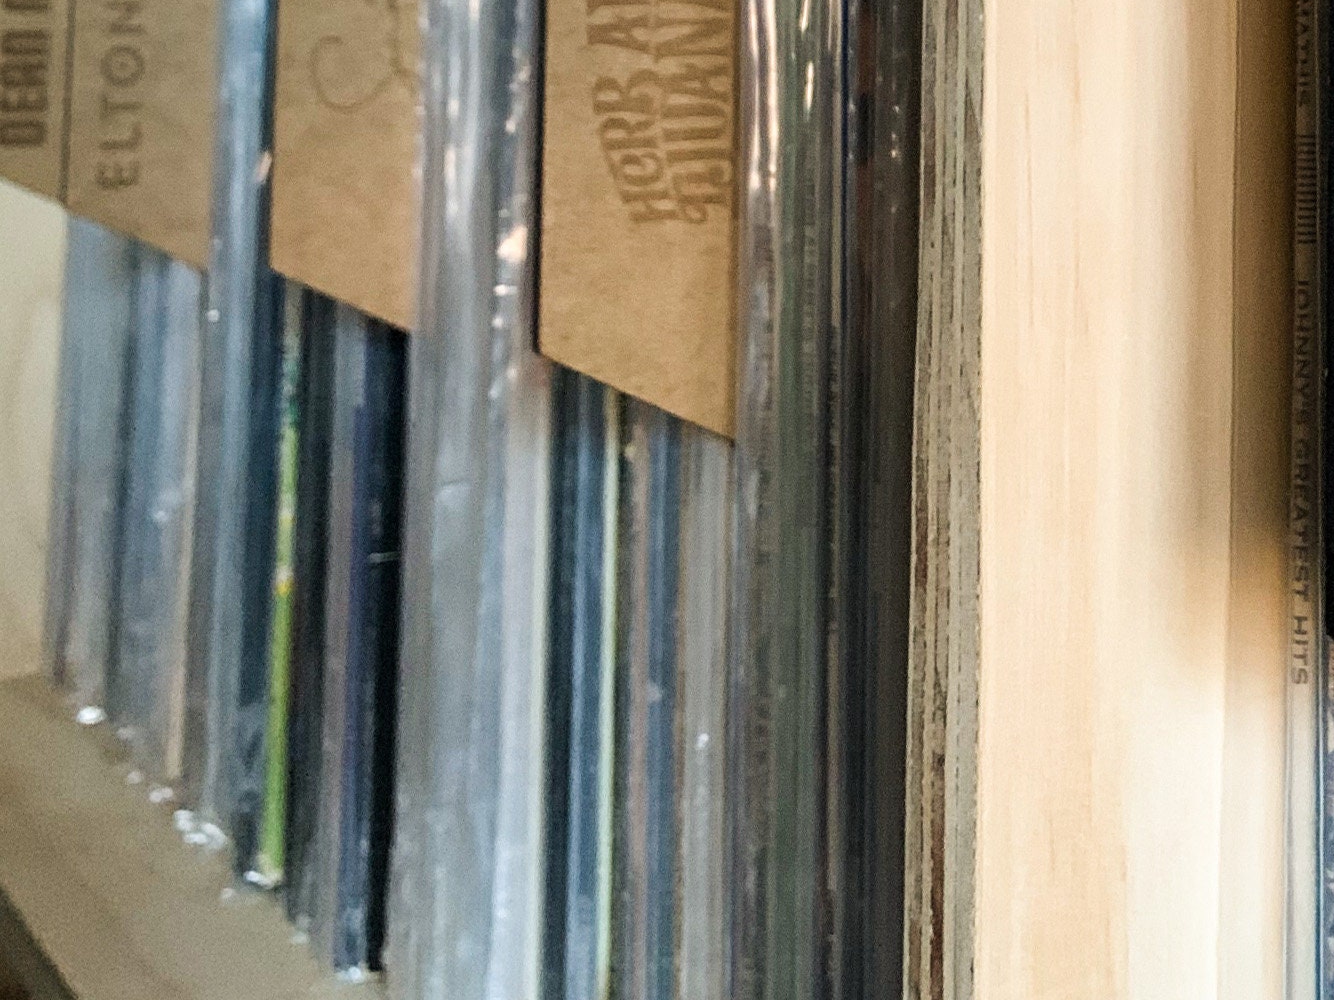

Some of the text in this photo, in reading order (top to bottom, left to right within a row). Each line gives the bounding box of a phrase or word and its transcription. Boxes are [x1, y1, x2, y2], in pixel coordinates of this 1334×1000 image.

[0, 28, 50, 147] DEAN
[98, 1, 148, 193] ELTON
[593, 69, 679, 223] HERB
[1293, 438, 1310, 602] GREATEST
[1291, 613, 1309, 686] HITS
